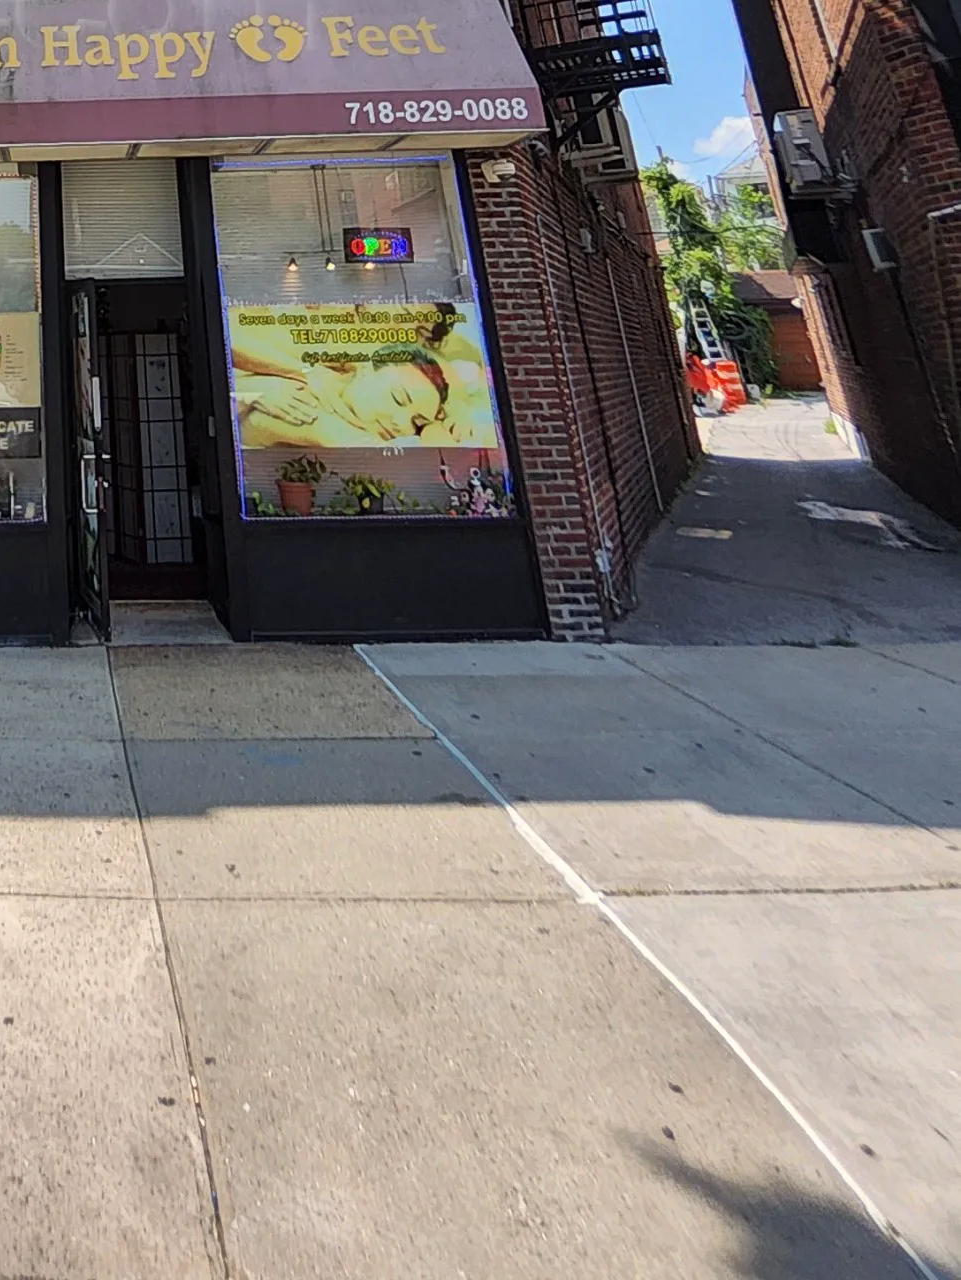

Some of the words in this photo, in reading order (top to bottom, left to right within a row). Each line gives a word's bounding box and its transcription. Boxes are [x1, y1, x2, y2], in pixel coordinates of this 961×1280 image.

[41, 24, 215, 80] Happy
[321, 15, 446, 58] Feet
[345, 97, 528, 125] 718-829-0088
[350, 236, 408, 256] OPEN
[239, 313, 275, 326] Seven
[277, 312, 308, 327] days
[310, 314, 320, 325] a
[321, 312, 355, 325] week
[358, 311, 391, 324] 10:00
[445, 312, 467, 325] pm
